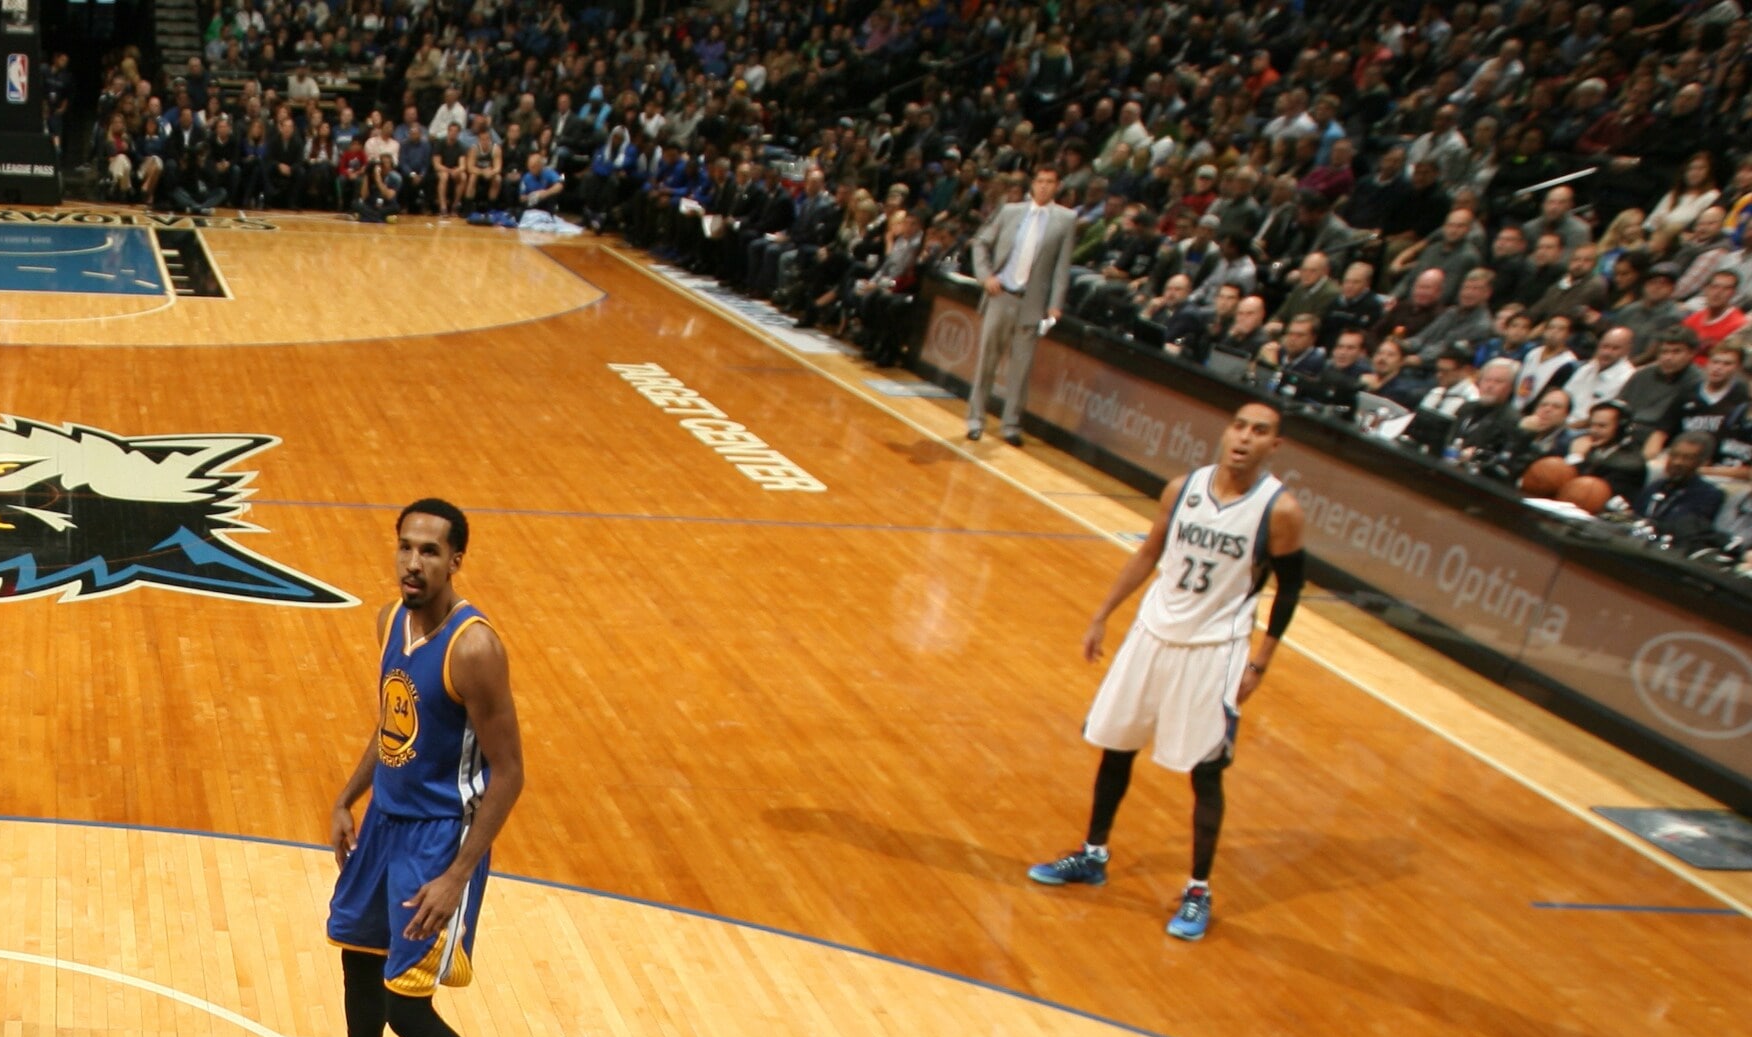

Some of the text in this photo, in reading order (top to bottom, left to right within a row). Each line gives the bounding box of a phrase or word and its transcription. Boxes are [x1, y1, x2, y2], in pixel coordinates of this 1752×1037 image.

[2, 162, 32, 175] LEAGUE
[33, 164, 54, 176] PASS
[606, 362, 828, 492] TARGET CENTER
[1054, 368, 1166, 458] Introducing
[1177, 519, 1249, 560] WOLVES
[1176, 556, 1217, 595] 23
[1437, 544, 1571, 645] Optima
[393, 696, 409, 718] 34
[1650, 644, 1744, 728] KIA
